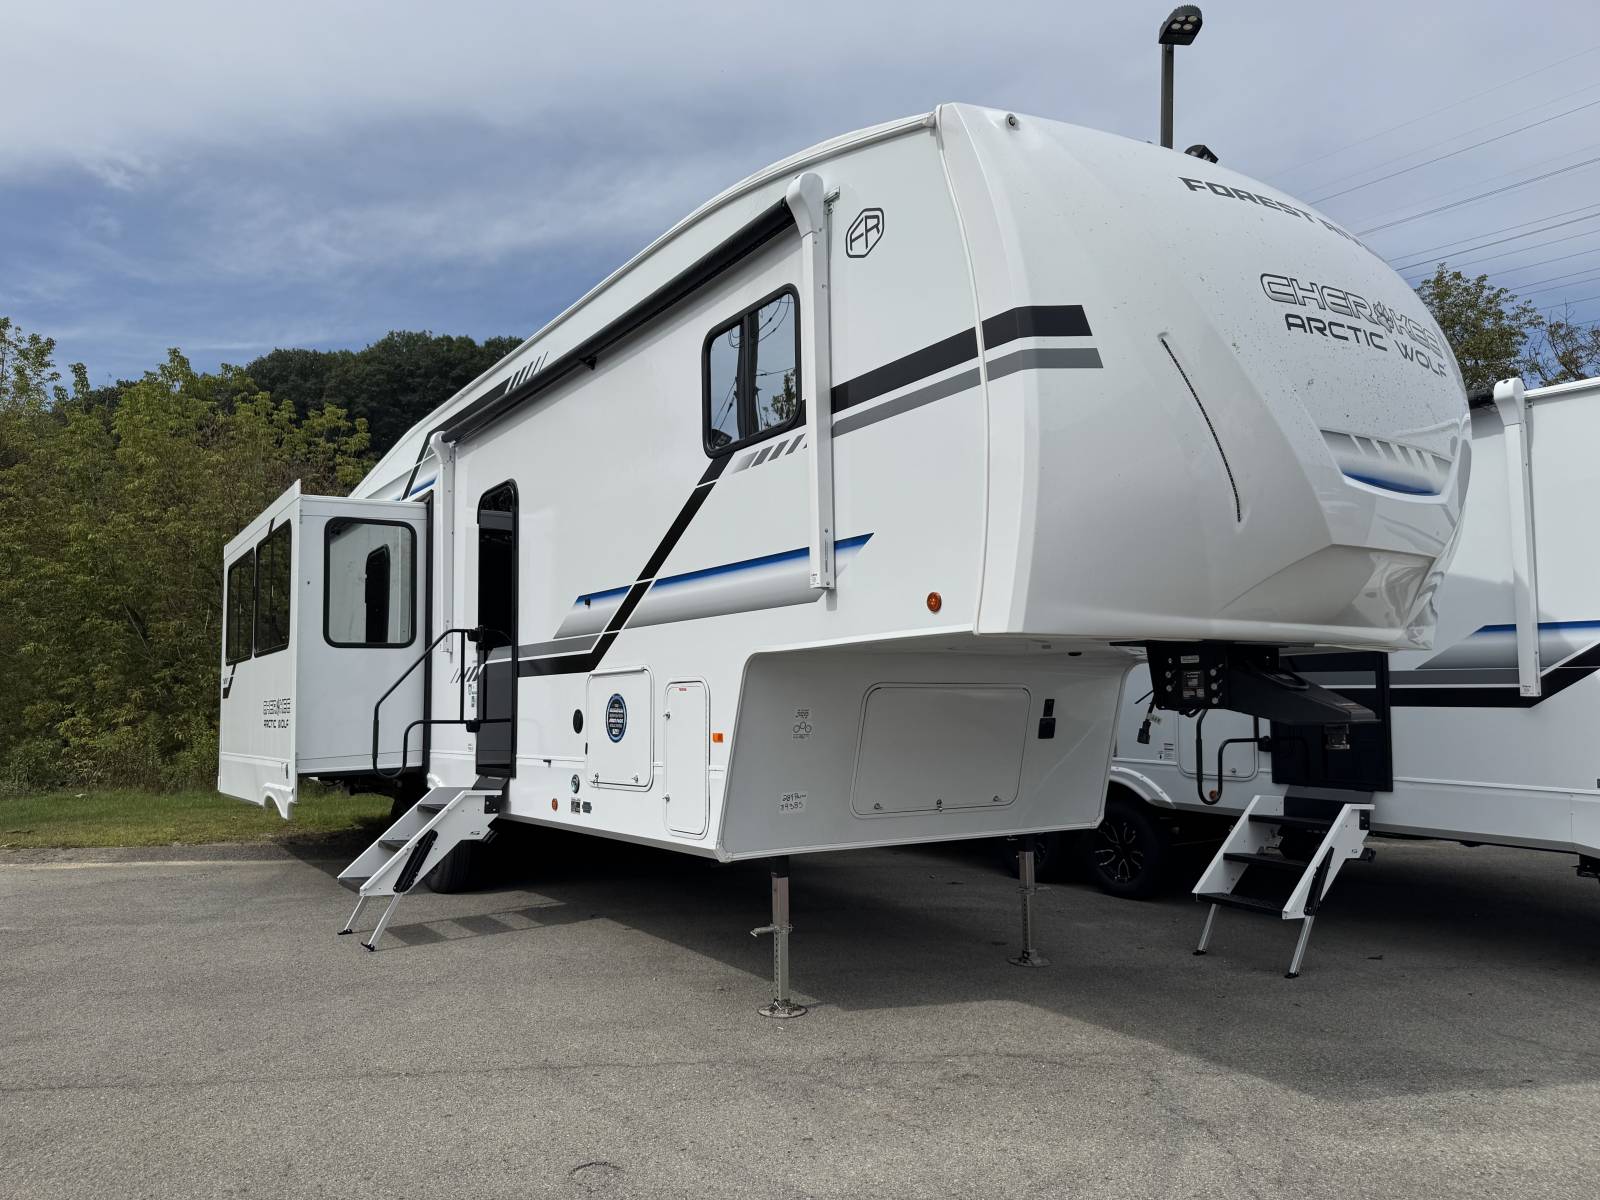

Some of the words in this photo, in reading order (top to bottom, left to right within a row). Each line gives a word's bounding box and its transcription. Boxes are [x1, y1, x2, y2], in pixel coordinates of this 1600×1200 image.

[1178, 176, 1315, 223] FOREST
[1285, 313, 1388, 352] ARCTIC
[1394, 339, 1447, 378] WOLF
